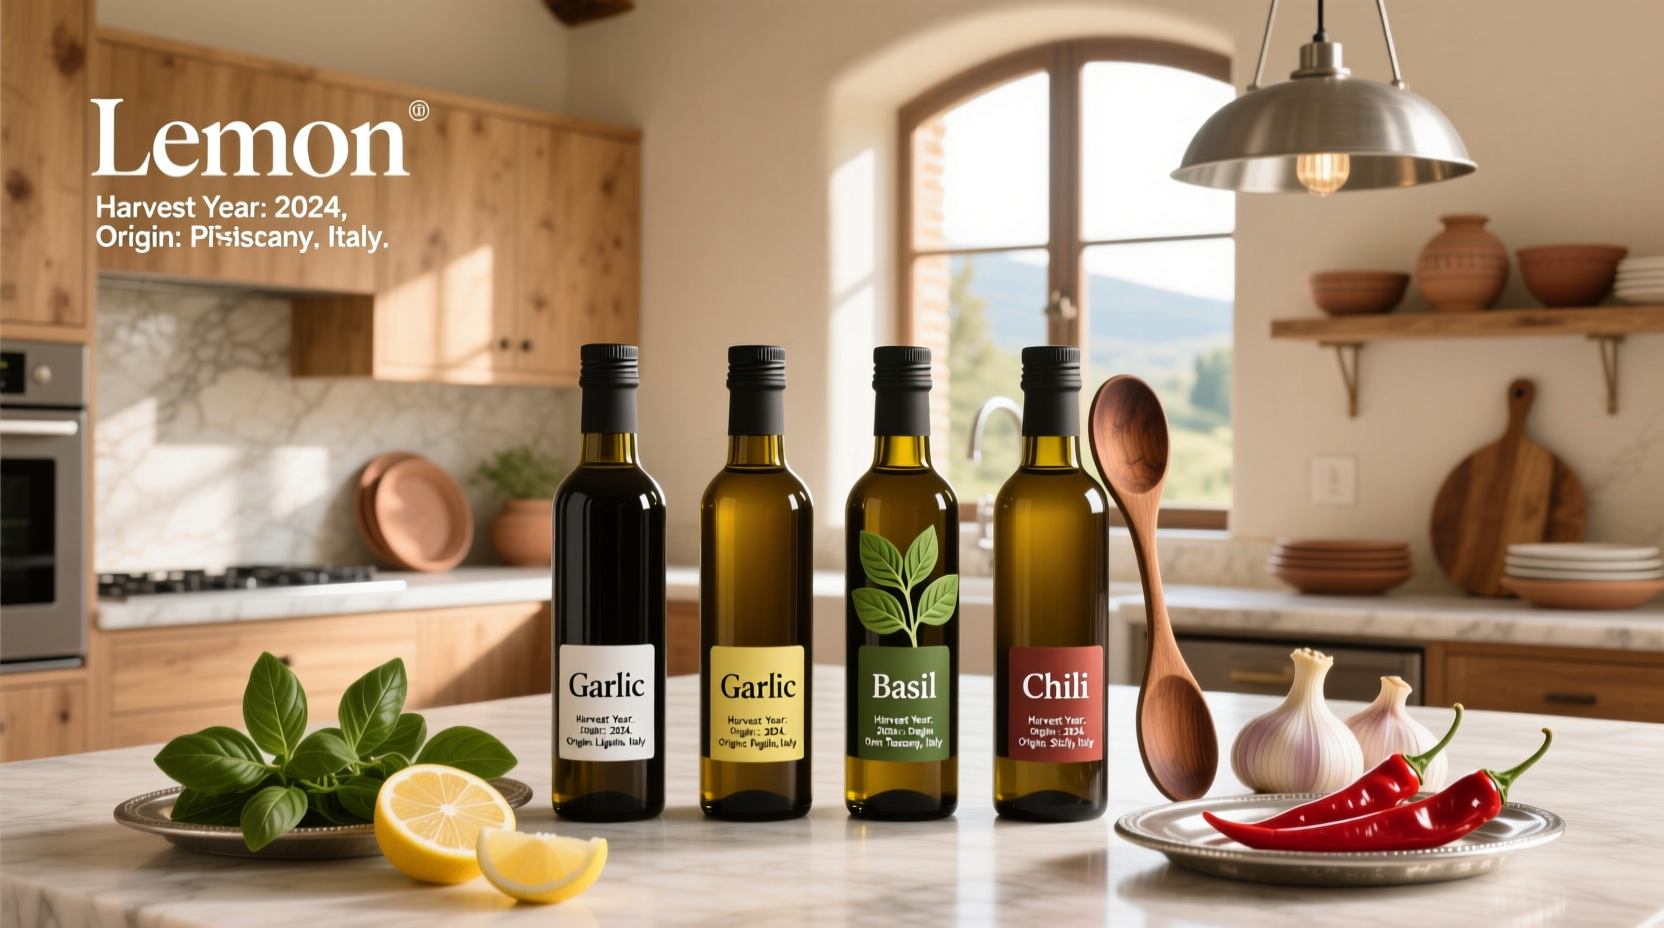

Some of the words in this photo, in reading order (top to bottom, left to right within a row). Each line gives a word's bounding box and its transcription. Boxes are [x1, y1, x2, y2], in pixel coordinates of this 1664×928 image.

[568, 671, 645, 698] Garlic
[720, 672, 796, 699] Garlic
[872, 671, 937, 699] Basil
[1022, 671, 1089, 699] Chili
